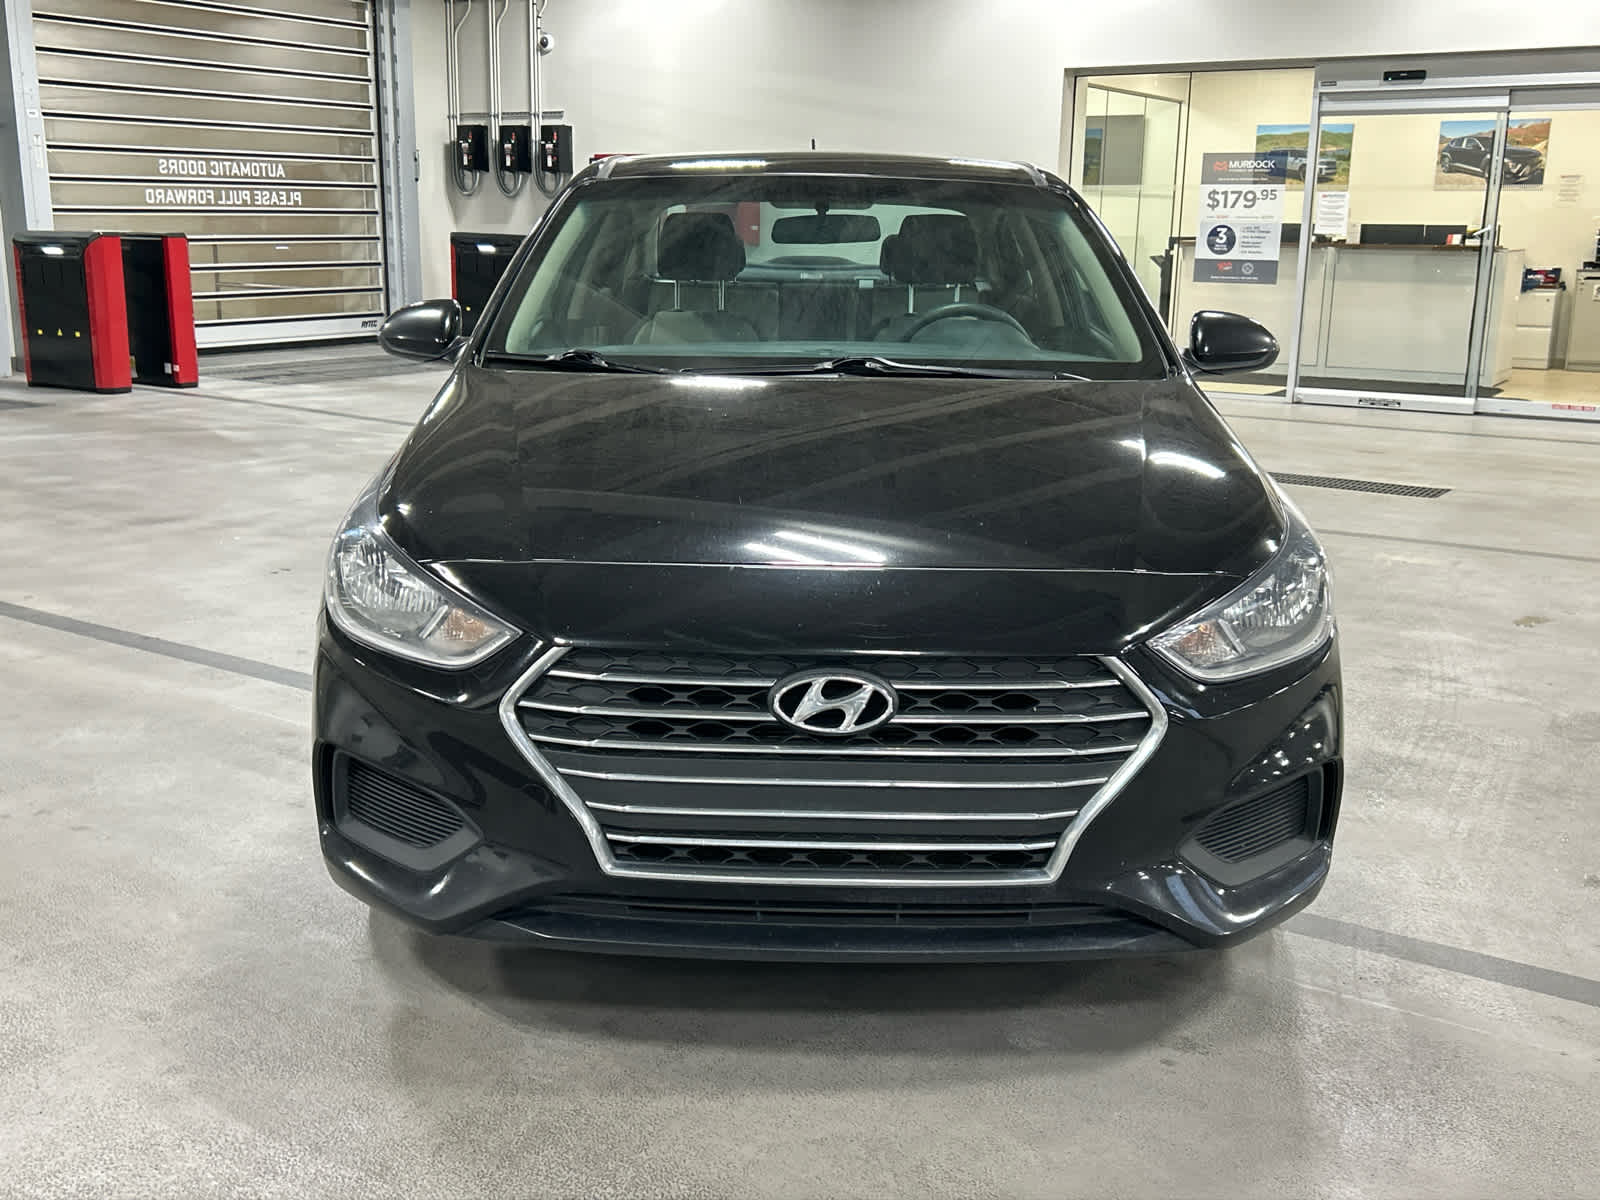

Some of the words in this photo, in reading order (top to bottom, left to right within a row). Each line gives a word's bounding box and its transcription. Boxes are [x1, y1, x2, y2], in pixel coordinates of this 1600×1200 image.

[1228, 160, 1276, 169] MURDOCK
[1206, 188, 1278, 212] $179.95
[1215, 227, 1229, 244] 3
